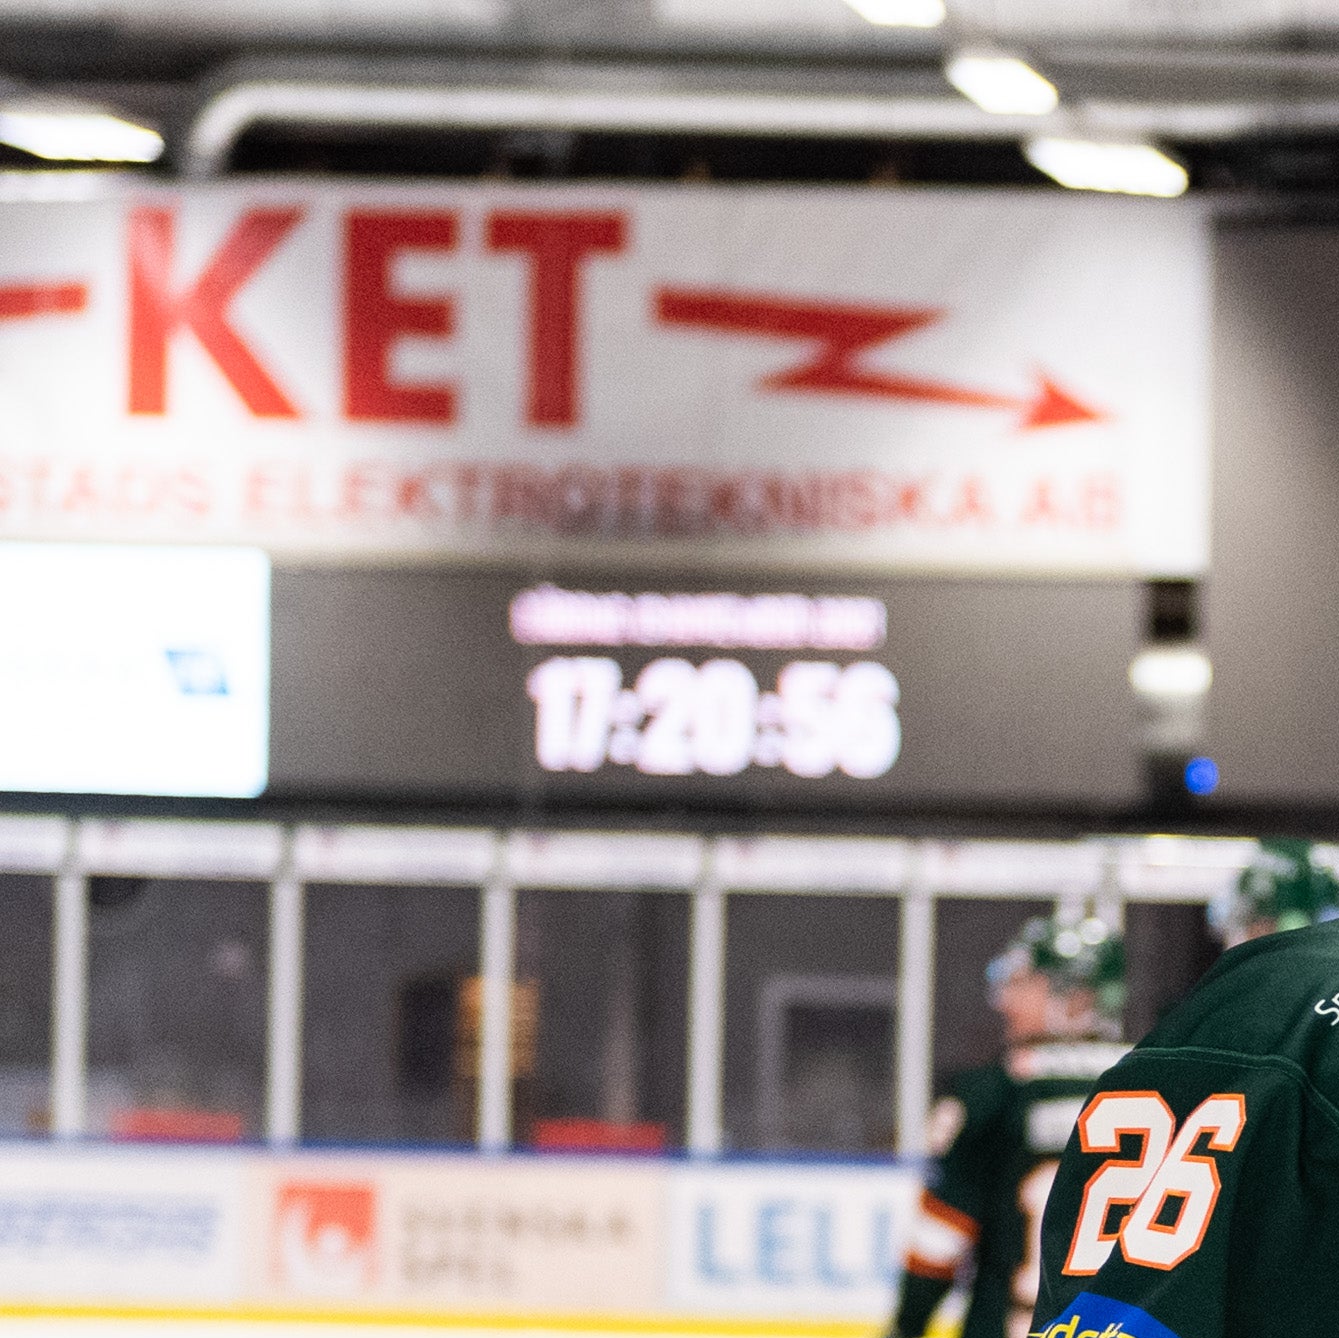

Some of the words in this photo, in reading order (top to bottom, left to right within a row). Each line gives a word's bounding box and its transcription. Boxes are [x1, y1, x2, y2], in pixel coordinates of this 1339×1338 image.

[125, 207, 628, 428] KET
[1020, 471, 1124, 529] AB
[527, 656, 900, 779] 17:20:56
[1061, 1090, 1247, 1276] 26
